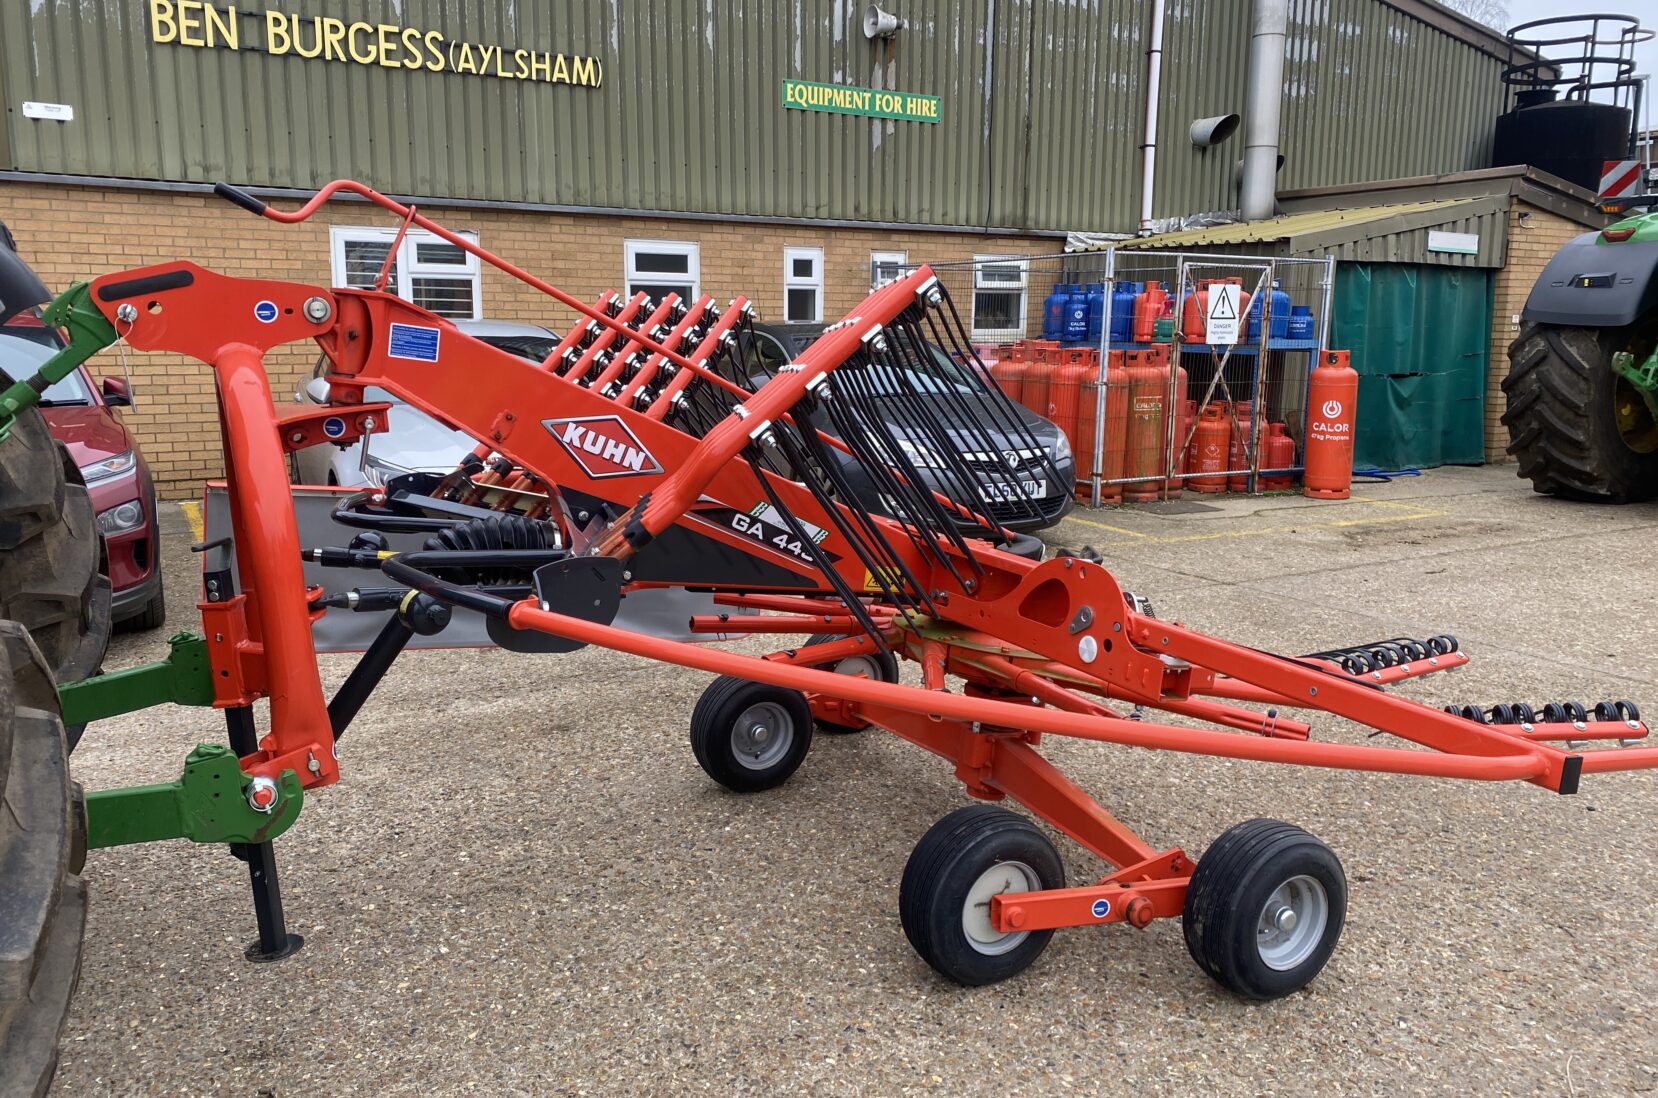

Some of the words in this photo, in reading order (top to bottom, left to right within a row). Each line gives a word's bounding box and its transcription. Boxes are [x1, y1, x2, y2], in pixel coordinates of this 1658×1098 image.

[151, 0, 238, 50] BEN
[266, 10, 446, 72] BURGESS
[449, 40, 602, 88] (AYLSHAM)
[786, 83, 872, 111] EQUIPMENT
[875, 94, 903, 113] FOR
[906, 99, 938, 117] HIRE
[1312, 422, 1349, 432] CALOR
[562, 421, 646, 472] KUHN
[731, 513, 764, 540] GA
